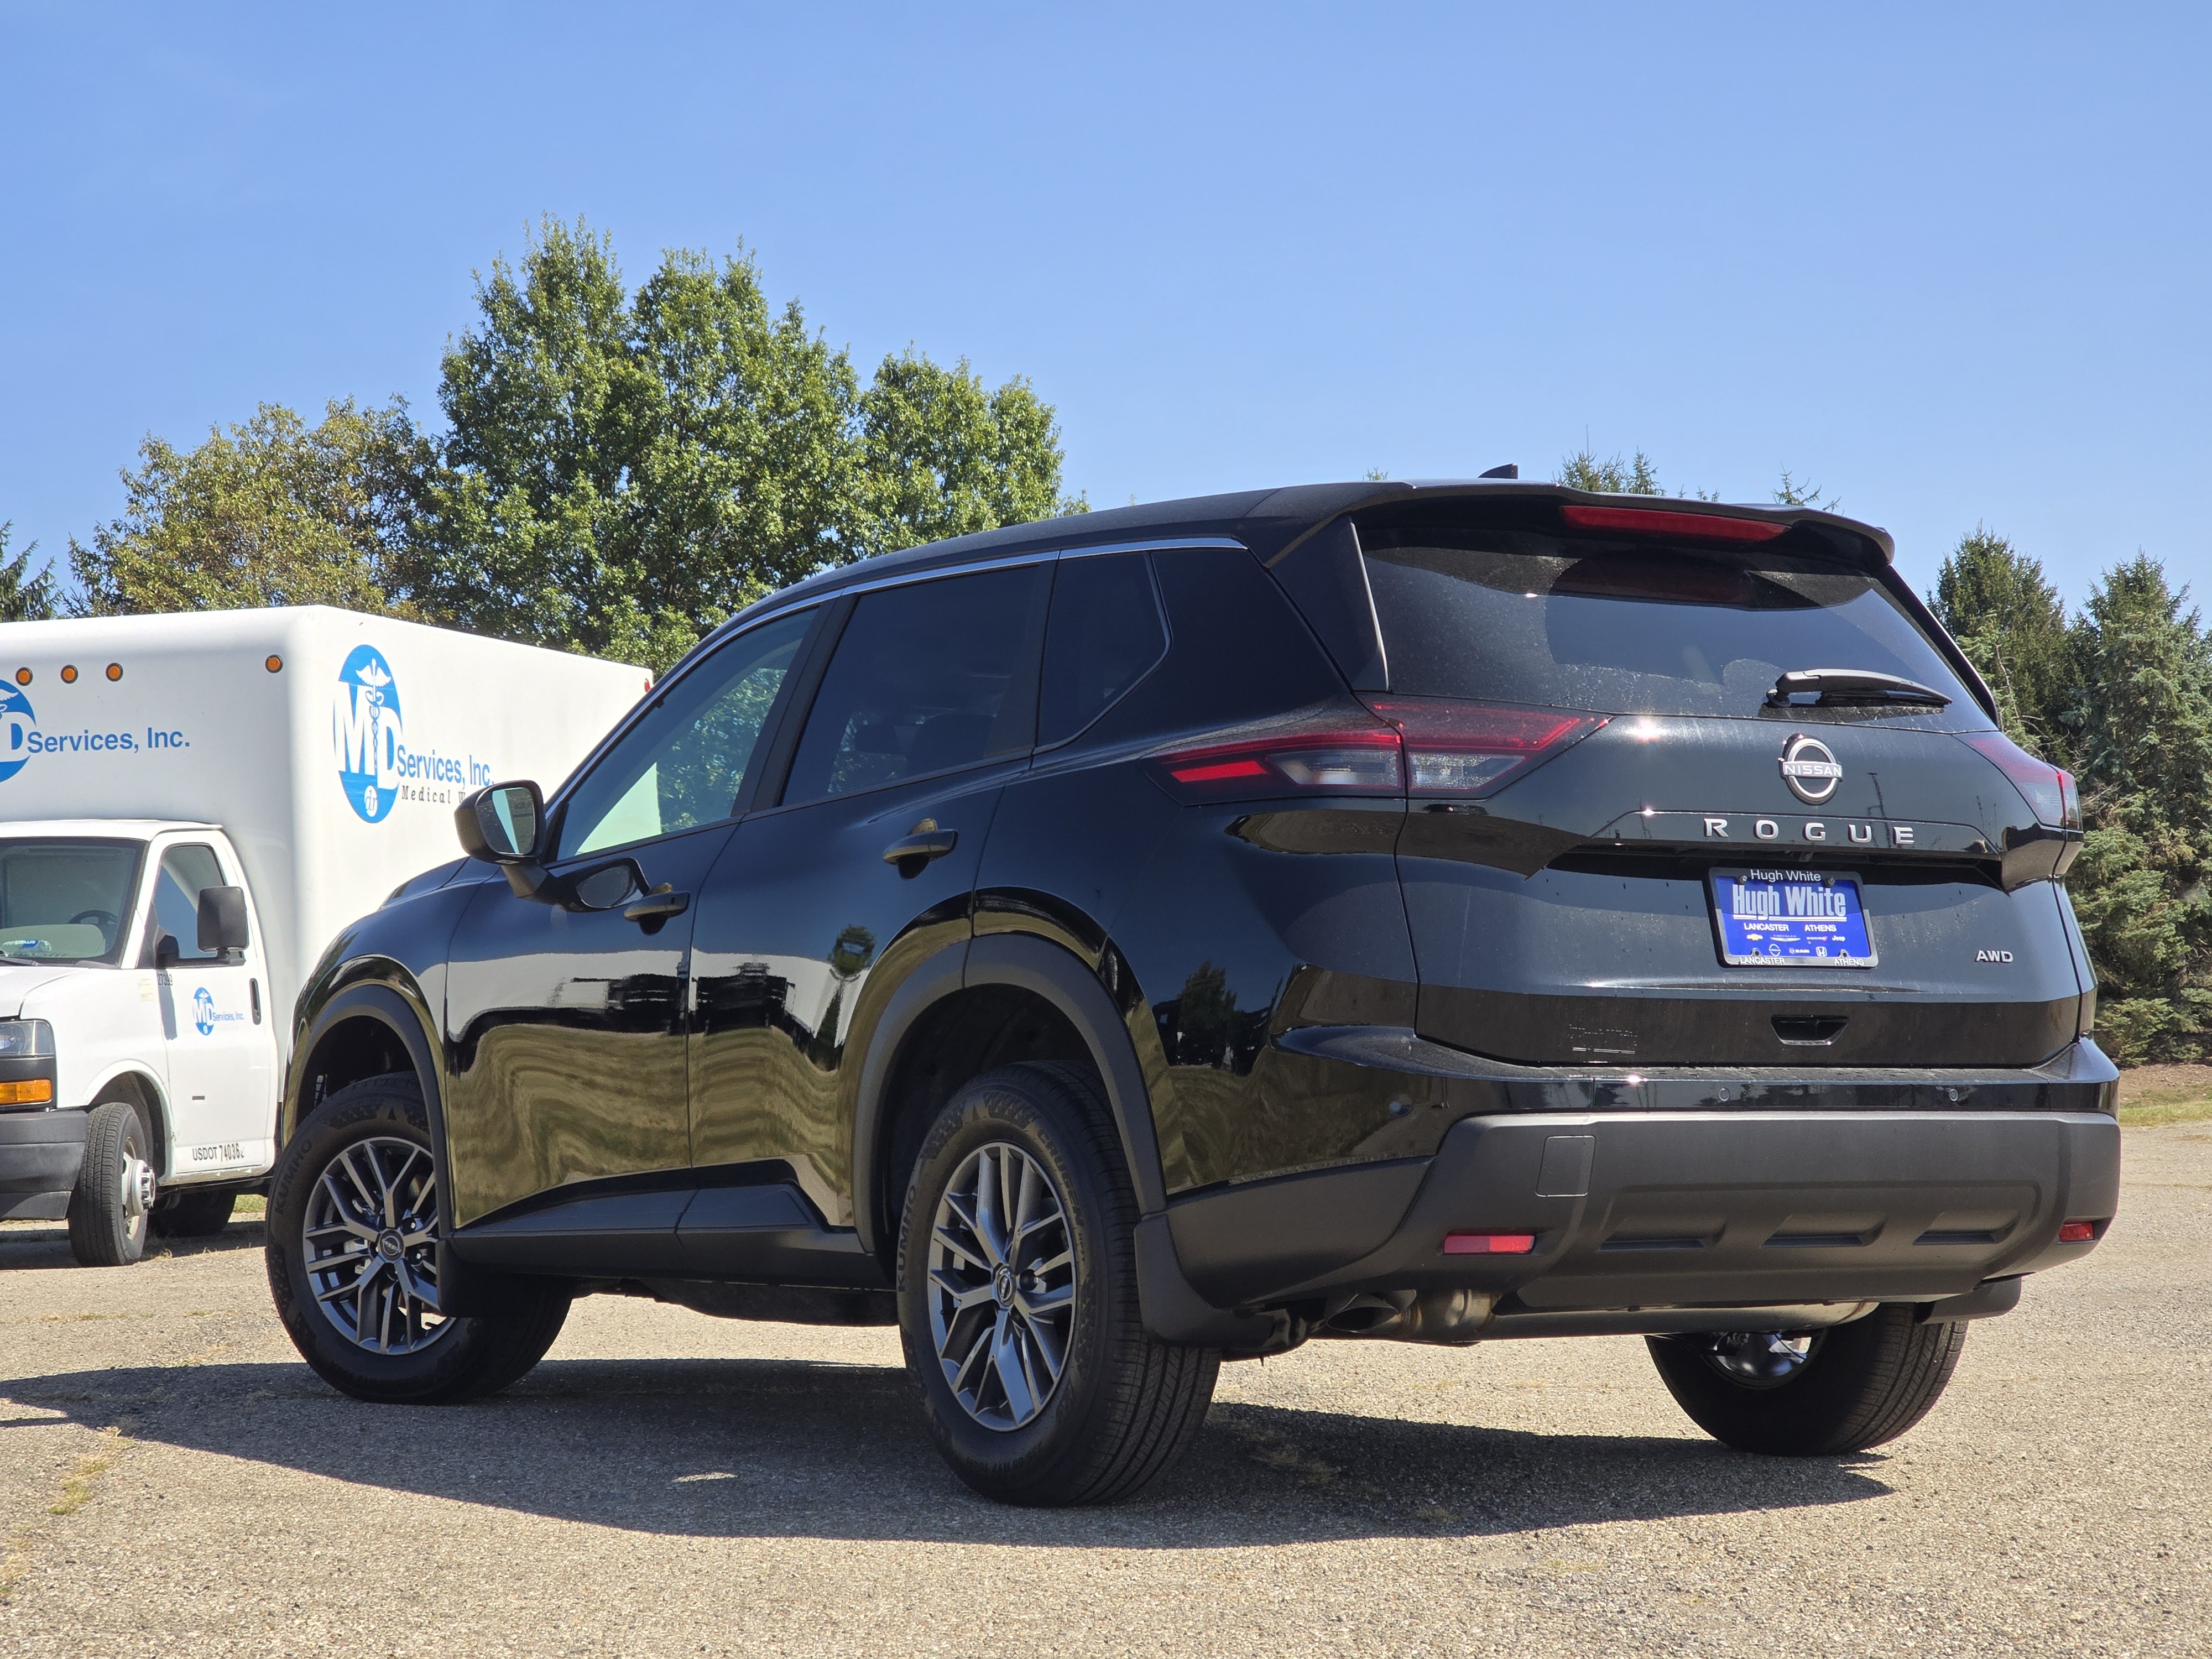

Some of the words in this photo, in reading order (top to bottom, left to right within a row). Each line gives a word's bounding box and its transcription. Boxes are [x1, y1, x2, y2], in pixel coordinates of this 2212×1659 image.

[27, 729, 139, 754] Services,
[147, 727, 190, 748] Inc.
[397, 744, 466, 790] Services,
[468, 754, 495, 787] Inc.
[1783, 764, 1843, 778] NISSAN
[401, 785, 452, 804] Medical
[1704, 817, 1916, 845] ROGUE
[1750, 869, 1783, 883] Hugh
[1786, 870, 1822, 882] White
[1732, 884, 1781, 921] Hugh
[1785, 886, 1847, 917] White
[1743, 922, 1790, 932] LANCASTER
[1804, 924, 1838, 932] ATHENS
[1739, 957, 1786, 966] LANCASTER
[1834, 958, 1865, 966] ATHENS
[1975, 950, 2014, 963] AWD
[212, 1012, 235, 1022] Services,
[234, 1011, 246, 1021] Inc.
[192, 1146, 218, 1161] USDOT
[274, 1139, 312, 1215] KUMHO
[898, 1184, 917, 1293] KUMHO
